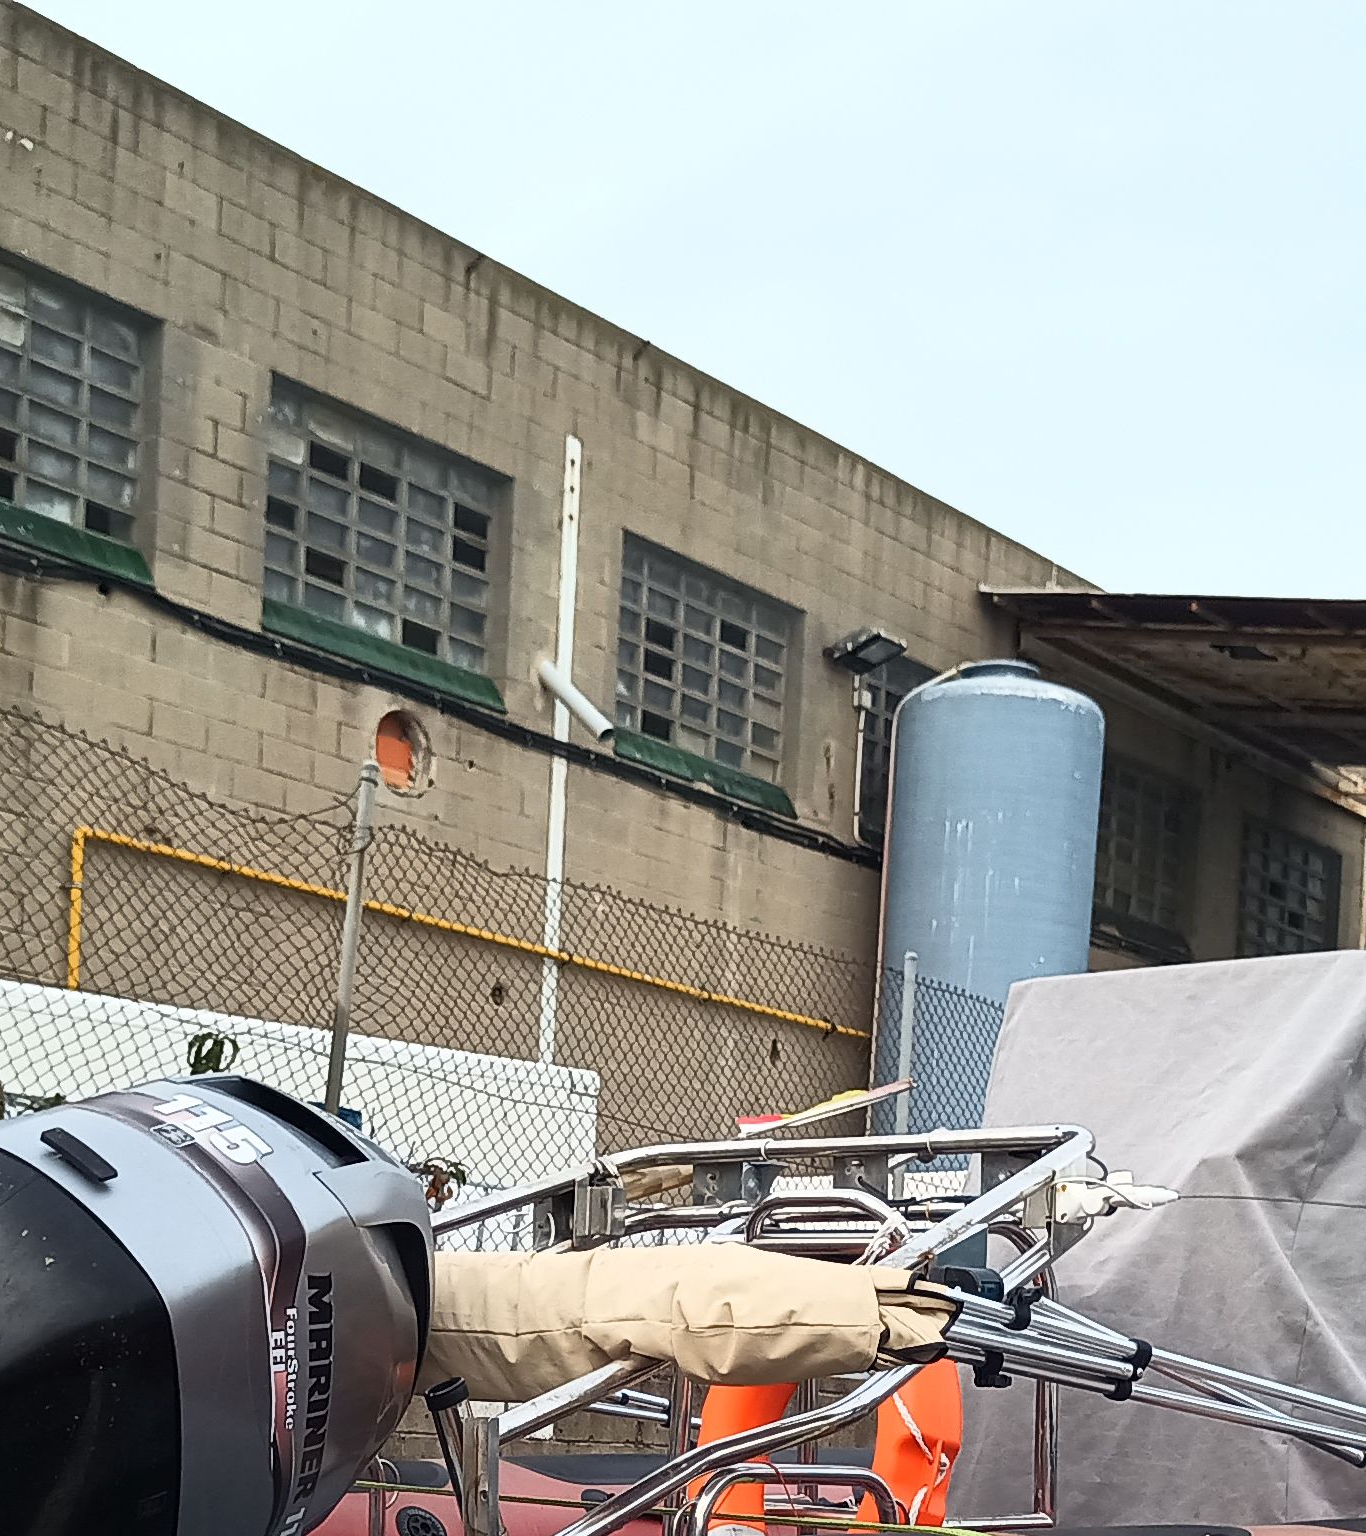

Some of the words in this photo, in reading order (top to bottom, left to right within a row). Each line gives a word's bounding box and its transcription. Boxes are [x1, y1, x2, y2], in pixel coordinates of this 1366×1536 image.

[153, 1092, 275, 1165] 115
[285, 1306, 298, 1430] FourStroke
[292, 1271, 333, 1505] MARINER
